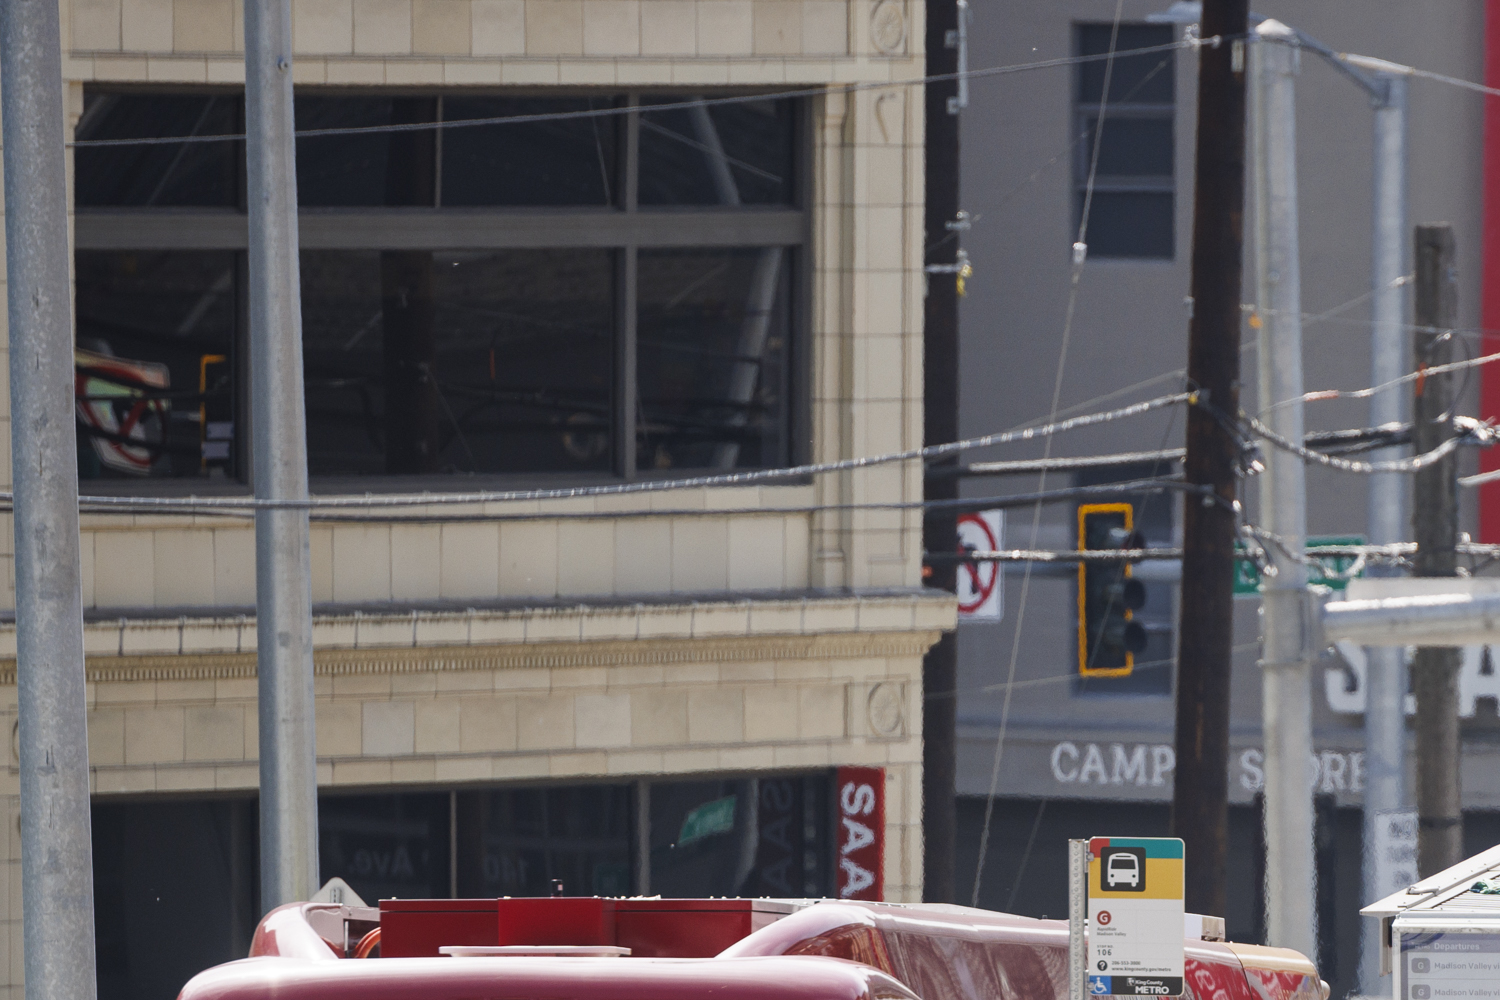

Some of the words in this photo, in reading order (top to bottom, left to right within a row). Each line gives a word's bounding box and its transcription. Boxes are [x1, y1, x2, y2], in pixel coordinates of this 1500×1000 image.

[1099, 913, 1108, 923] G
[1434, 943, 1480, 951] Departures
[1417, 962, 1425, 970] G
[1434, 962, 1467, 970] Madison
[1468, 962, 1493, 971] Valley
[1135, 986, 1170, 995] METRO
[1417, 989, 1425, 997] G
[1468, 989, 1493, 997] Valley
